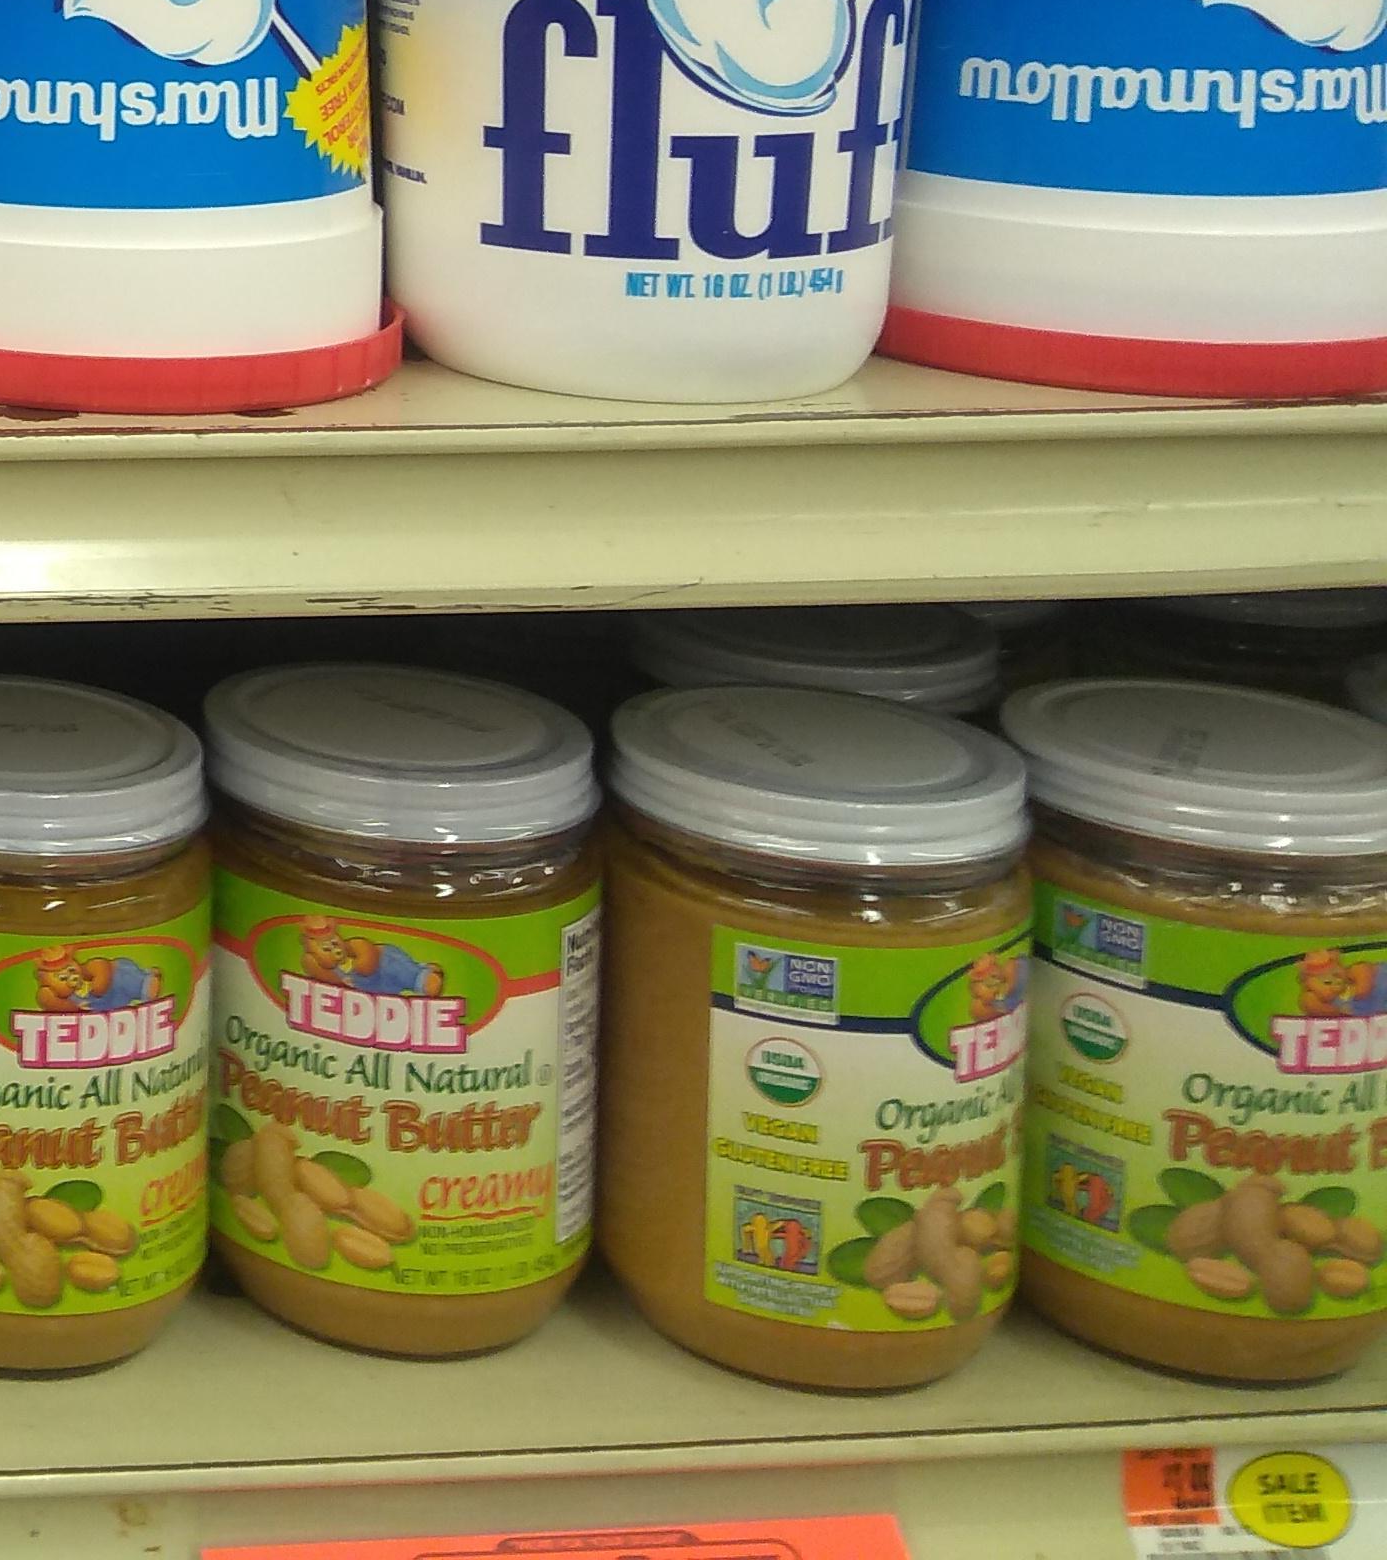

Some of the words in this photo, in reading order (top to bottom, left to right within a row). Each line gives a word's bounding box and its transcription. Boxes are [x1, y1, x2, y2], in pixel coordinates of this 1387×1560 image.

[789, 971, 831, 986] GMO
[790, 958, 831, 974] NON
[14, 1001, 175, 1063] TEDDIE
[282, 975, 465, 1048] TEDDIE
[226, 1014, 338, 1079] Organic
[344, 1052, 392, 1090] All
[405, 1050, 533, 1094] Natural
[80, 1069, 121, 1108] All
[219, 1049, 373, 1145] Peanut
[384, 1100, 542, 1153] Butter
[1182, 1073, 1330, 1125] Organic
[1339, 1074, 1374, 1111] All
[1163, 1107, 1359, 1174] Peanut
[419, 1162, 555, 1219] creamy
